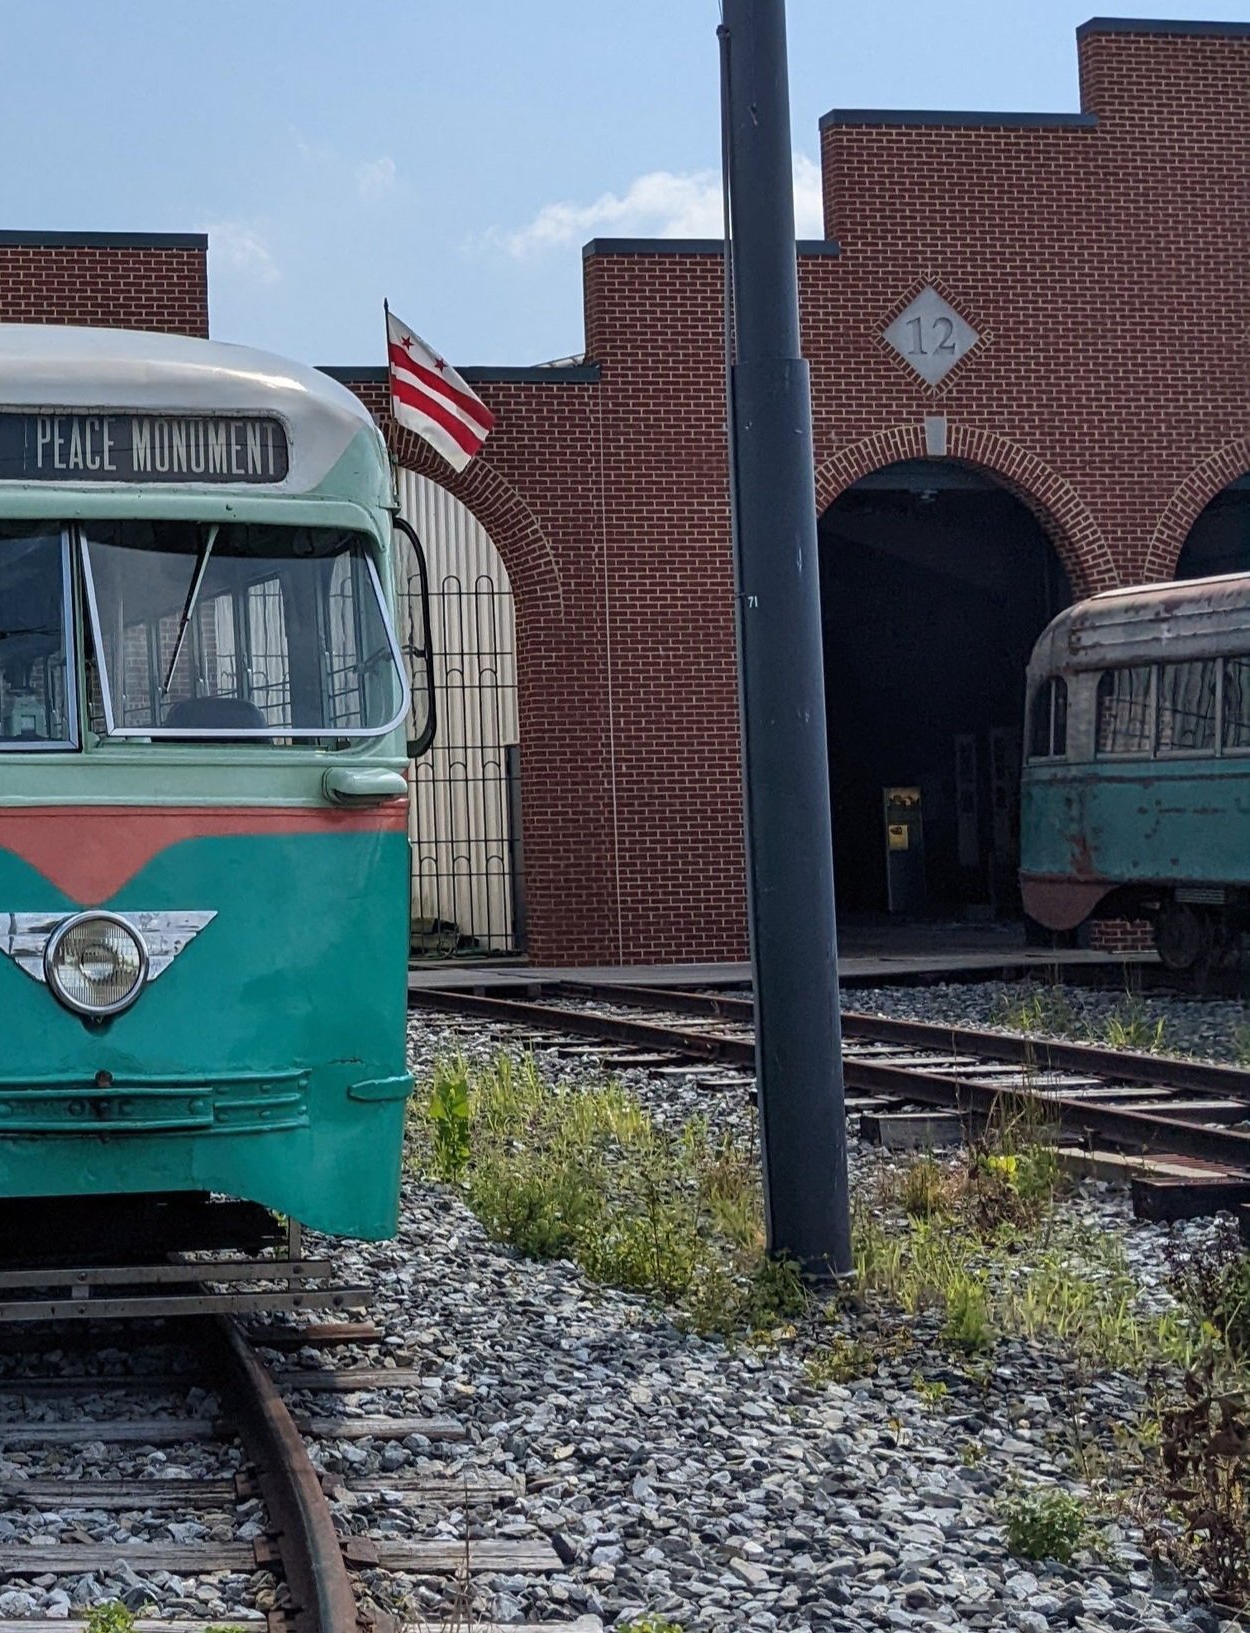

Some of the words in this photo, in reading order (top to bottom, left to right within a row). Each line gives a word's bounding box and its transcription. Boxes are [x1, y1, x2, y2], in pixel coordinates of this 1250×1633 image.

[906, 316, 956, 355] 12
[37, 416, 117, 471] PEACE
[132, 418, 277, 475] MONUMENT
